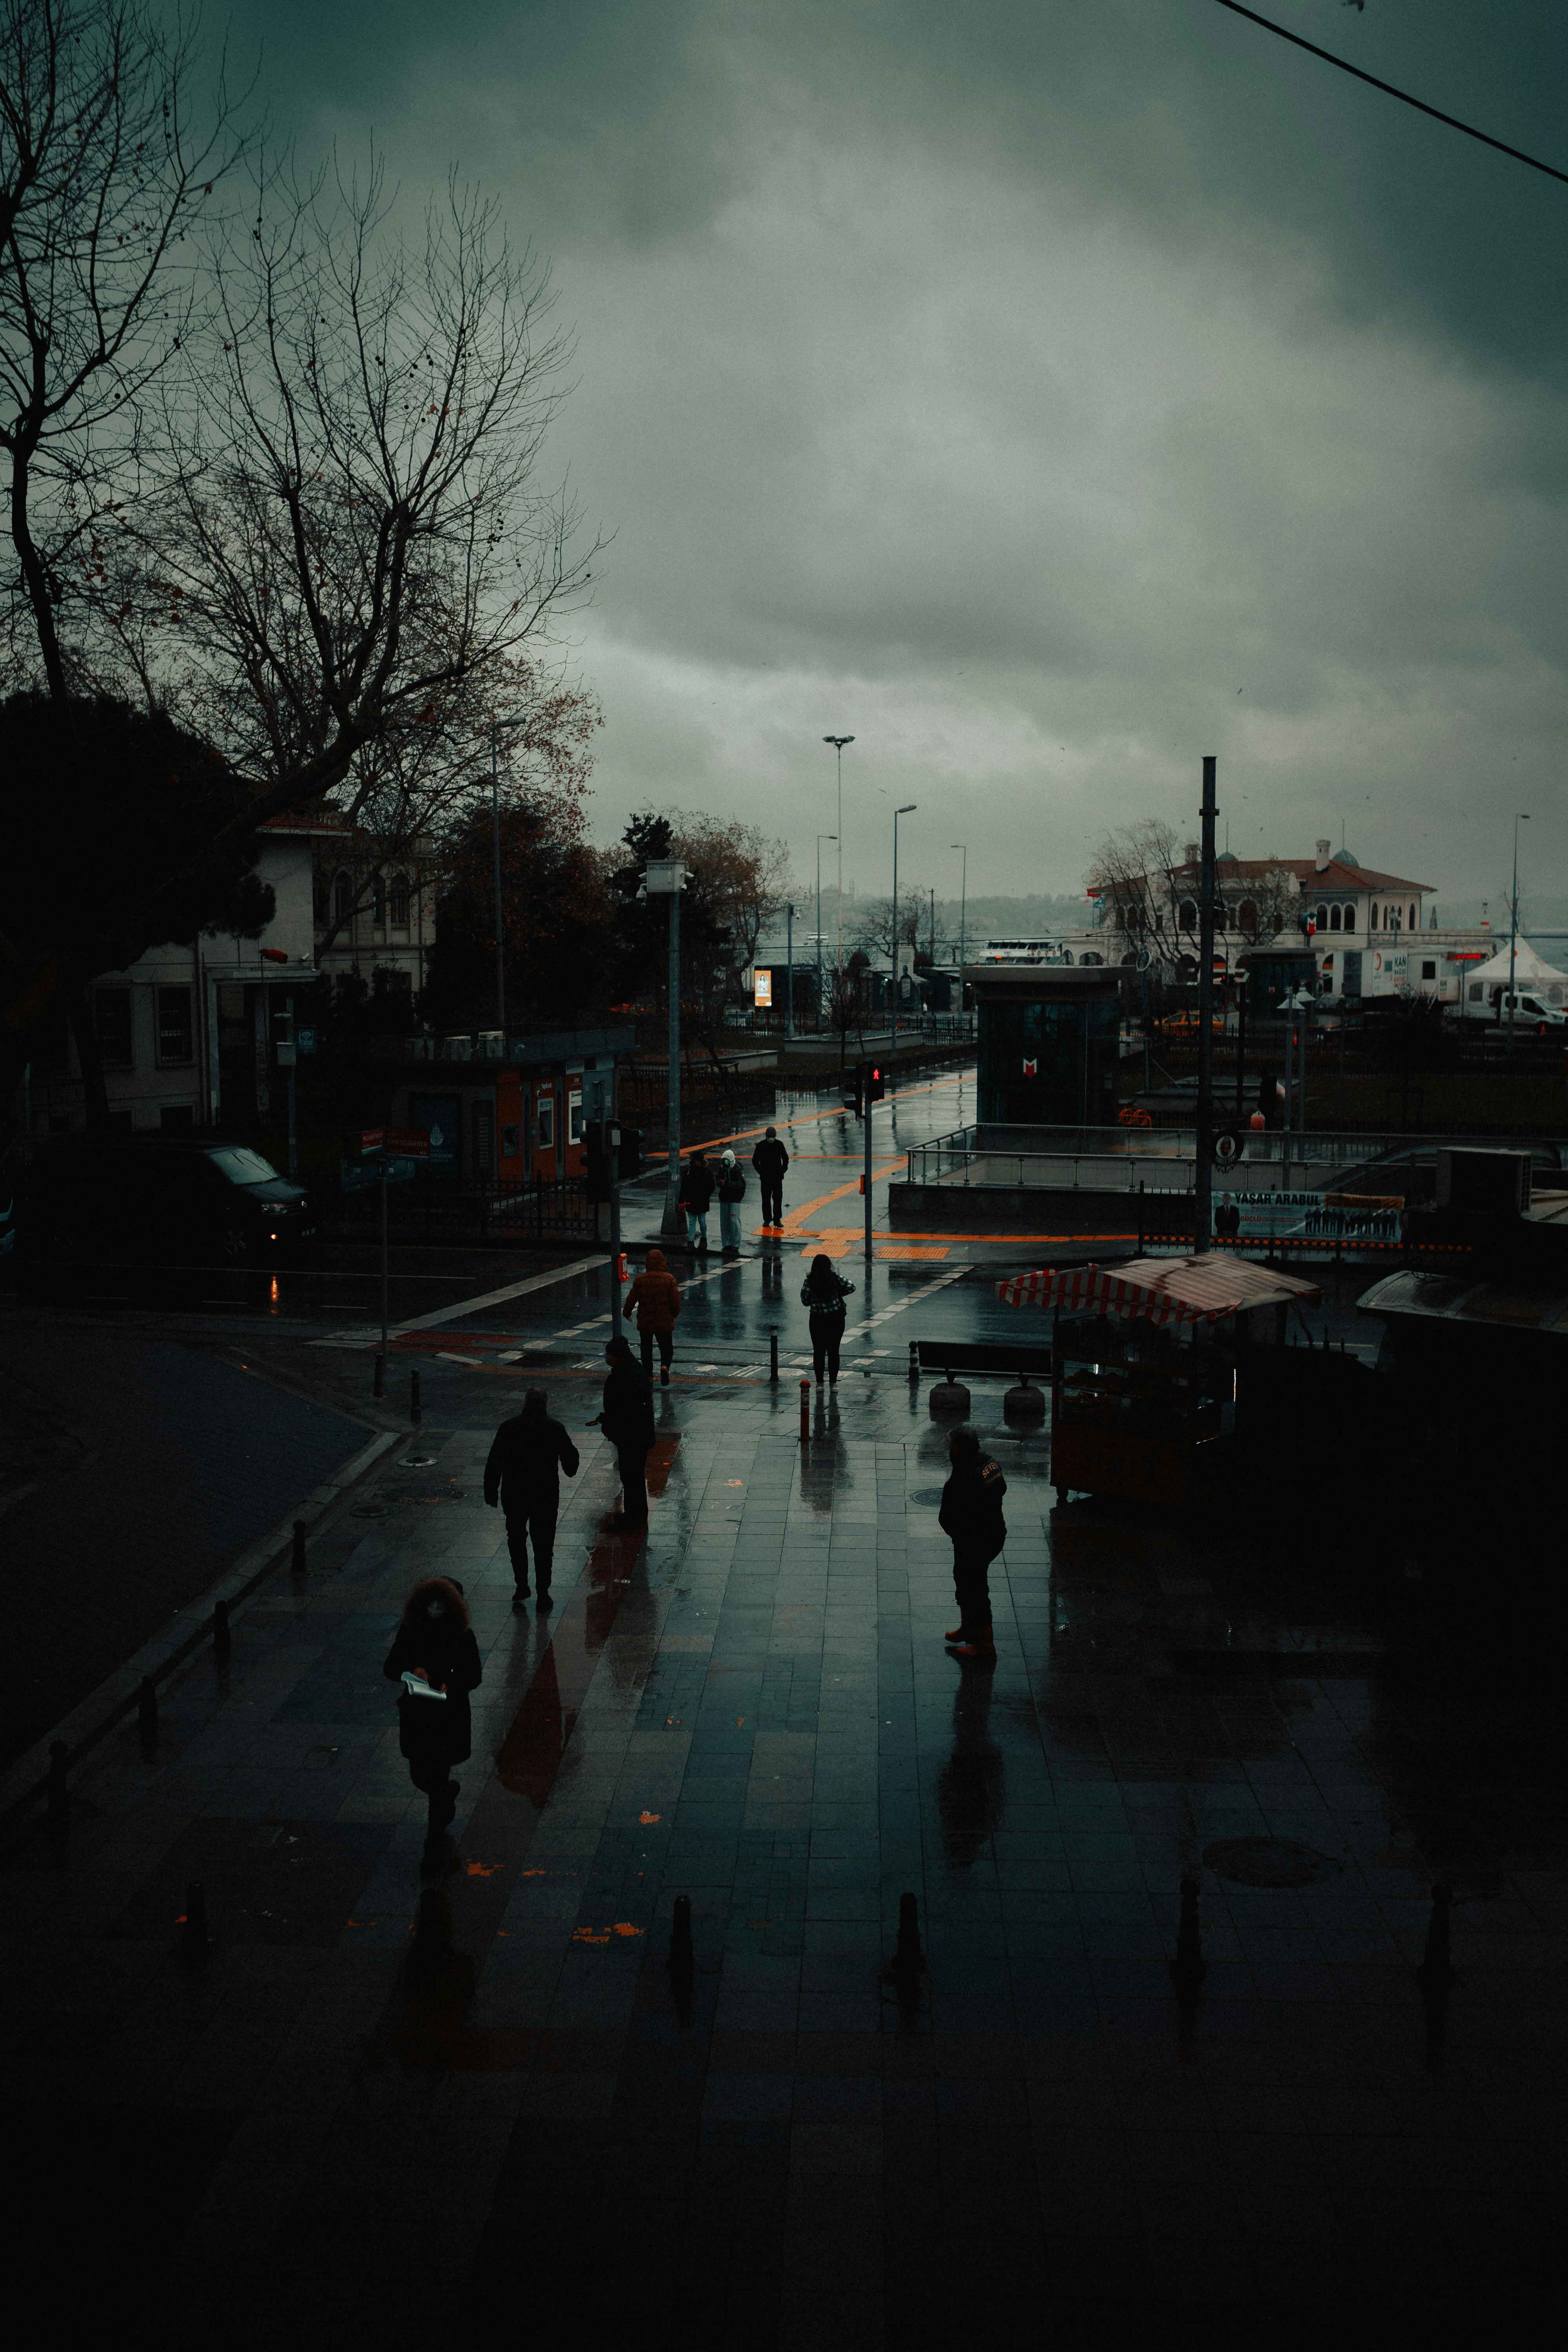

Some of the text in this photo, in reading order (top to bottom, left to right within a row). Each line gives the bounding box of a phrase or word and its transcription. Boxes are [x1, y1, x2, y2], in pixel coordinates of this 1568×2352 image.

[1394, 956, 1406, 967] KAN
[1024, 1058, 1037, 1073] M
[1235, 1193, 1271, 1205] YAŞAR
[1275, 1193, 1320, 1206] ARABUL
